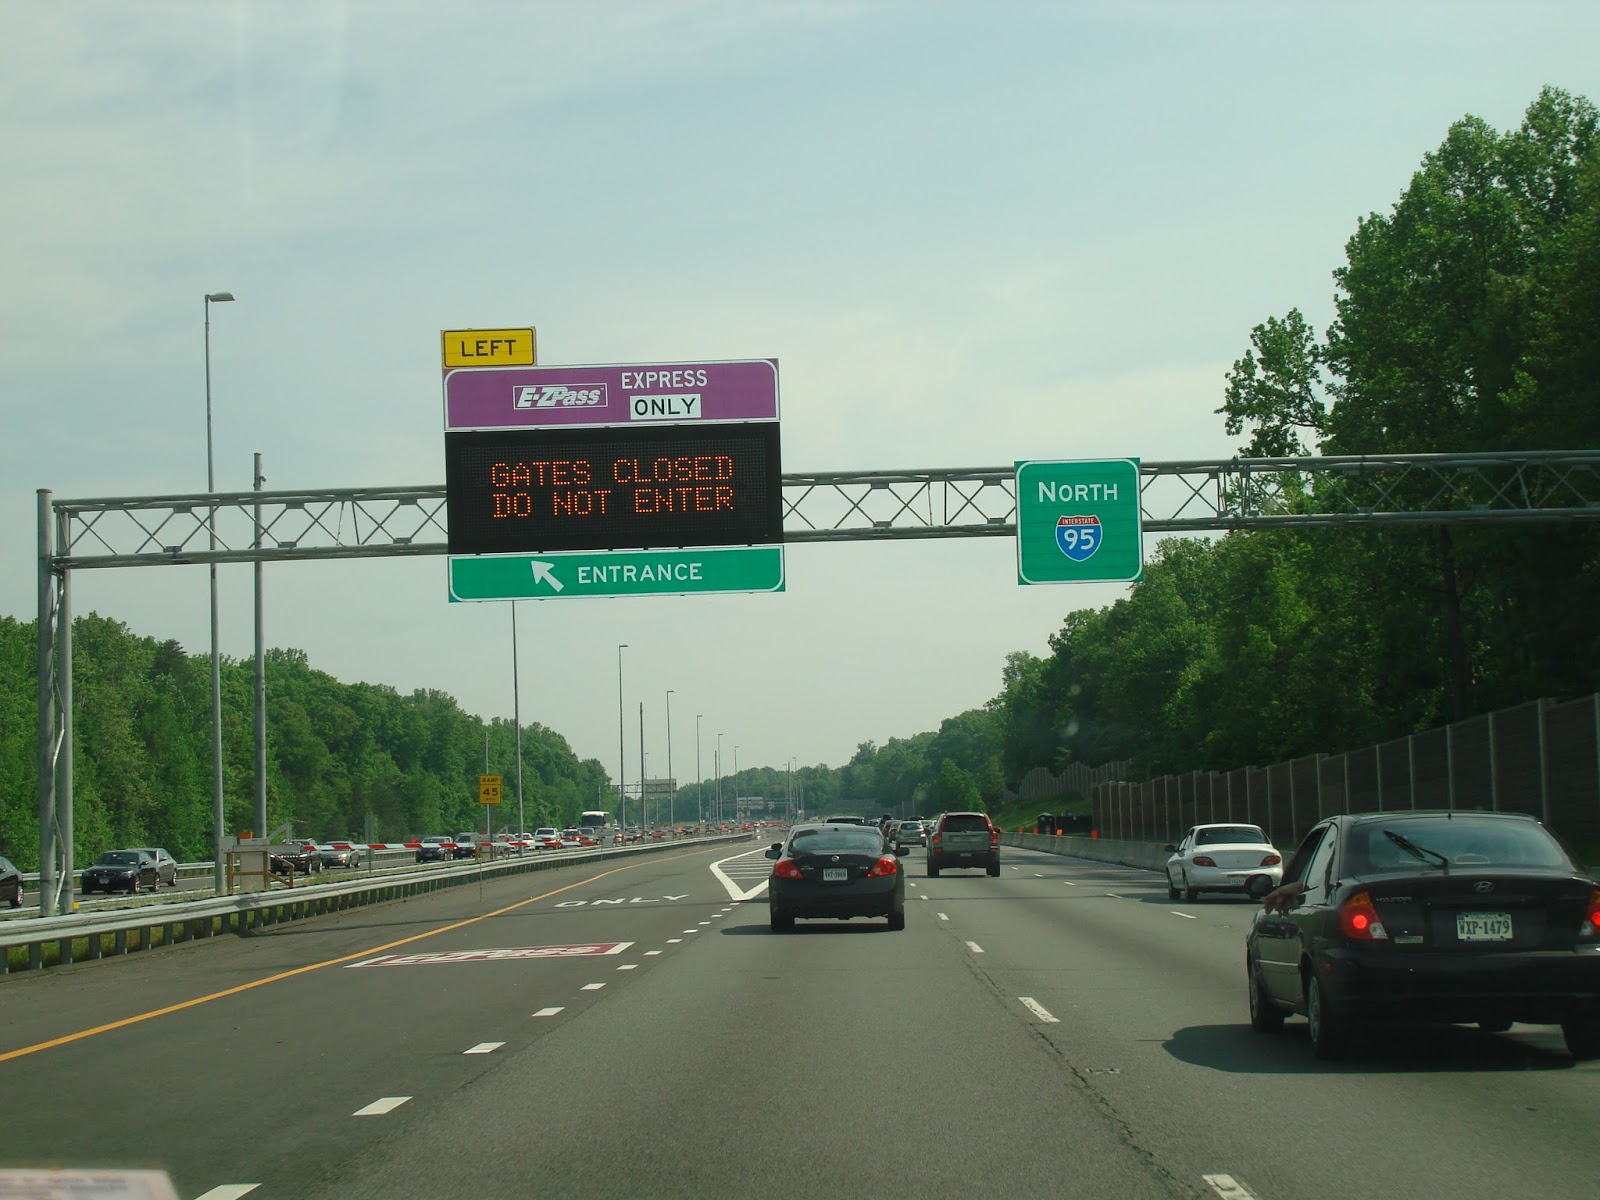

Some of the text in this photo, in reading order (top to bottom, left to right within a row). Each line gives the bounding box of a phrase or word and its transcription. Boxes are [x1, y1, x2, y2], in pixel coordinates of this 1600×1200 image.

[461, 339, 517, 357] LEFT
[621, 369, 708, 389] EXPRESS
[516, 386, 601, 407] E-ZPass
[634, 397, 696, 416] ONLY
[490, 455, 735, 488] GATES CLOSED
[1038, 481, 1118, 502] NORTH
[492, 486, 735, 518] DO NOT ENTER
[1063, 529, 1095, 550] 95
[577, 562, 703, 584] ENTRANCE
[482, 787, 499, 797] 45
[553, 893, 690, 908] ONLY
[1458, 920, 1510, 935] WXP-1479
